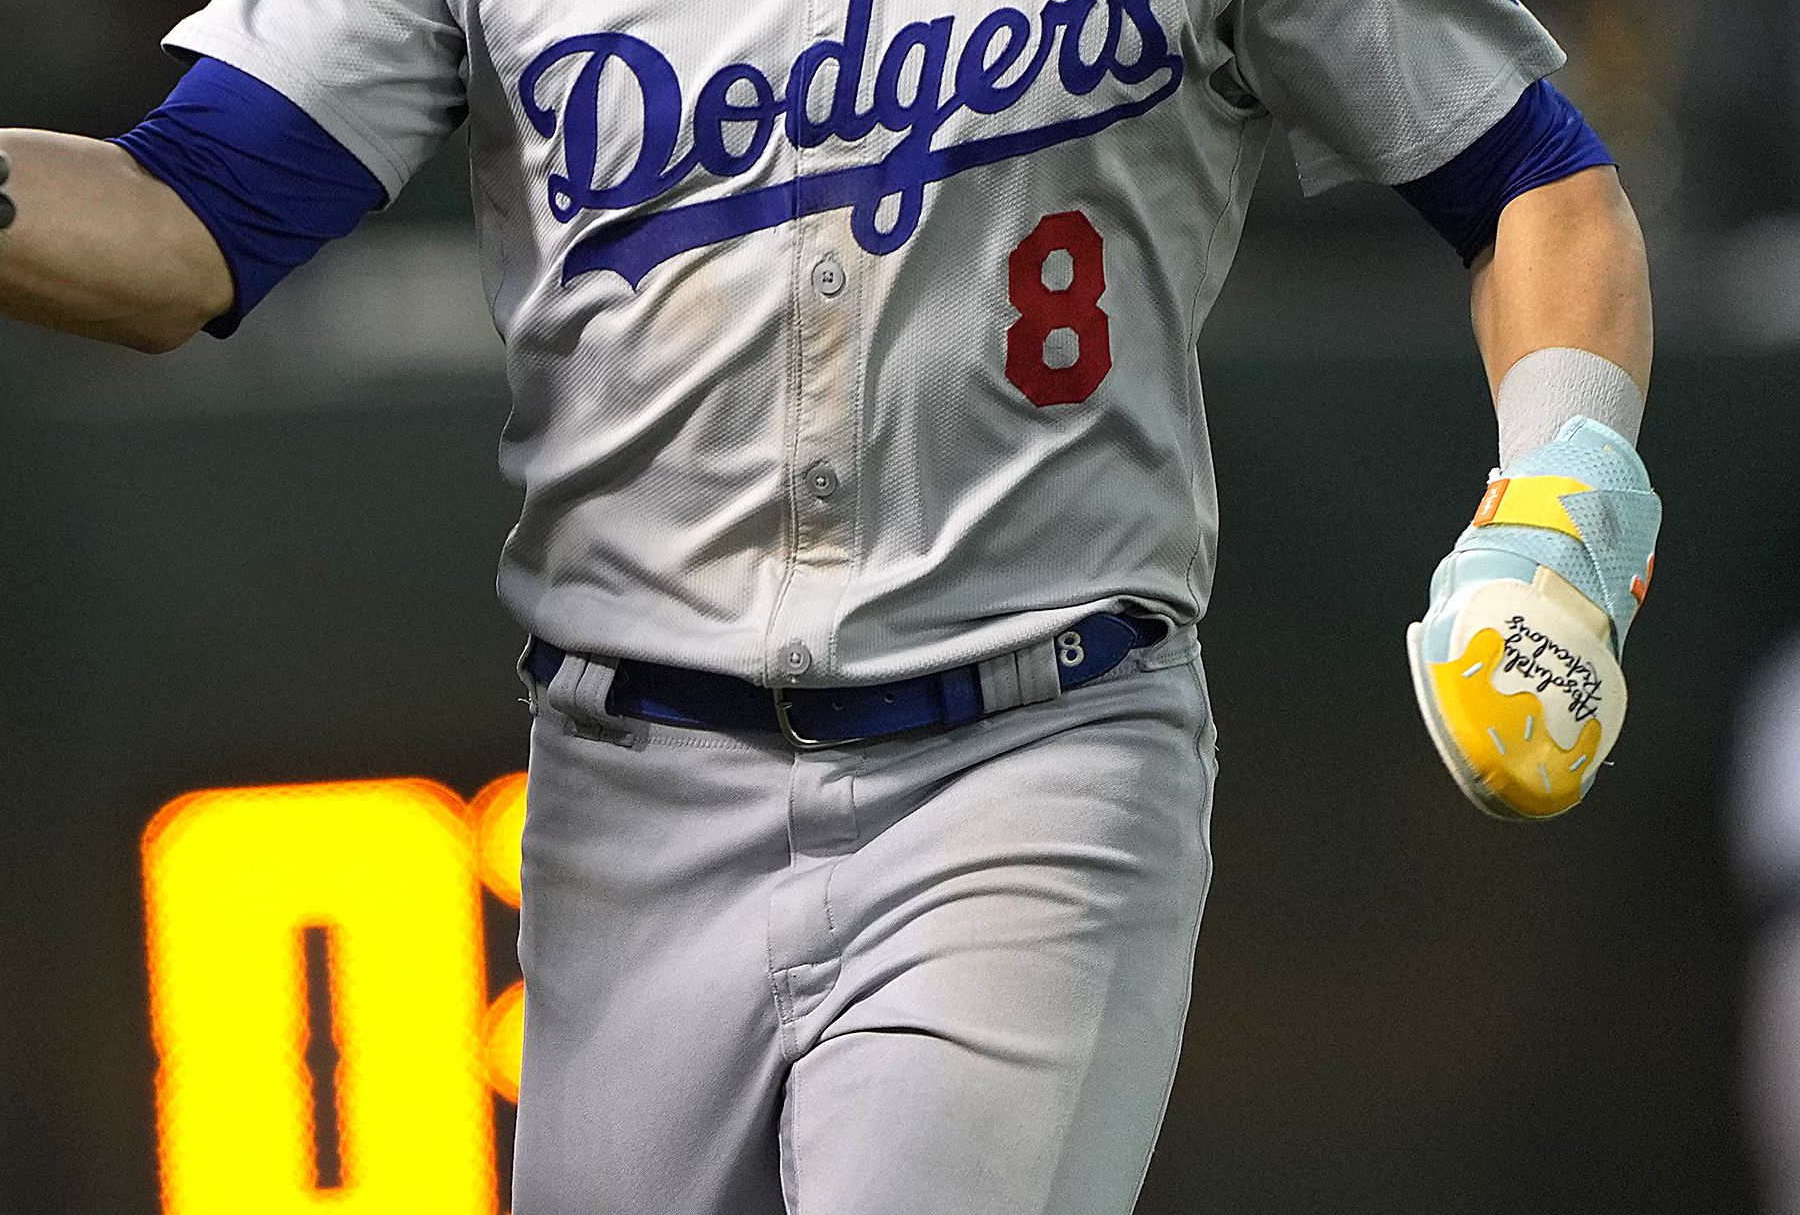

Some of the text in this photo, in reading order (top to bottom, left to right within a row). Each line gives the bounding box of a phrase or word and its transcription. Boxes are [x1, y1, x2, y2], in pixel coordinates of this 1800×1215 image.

[1004, 209, 1111, 408] 8
[1057, 631, 1085, 667] 8
[1503, 615, 1602, 701] Ridiculous
[1503, 632, 1599, 722] Absolutely
